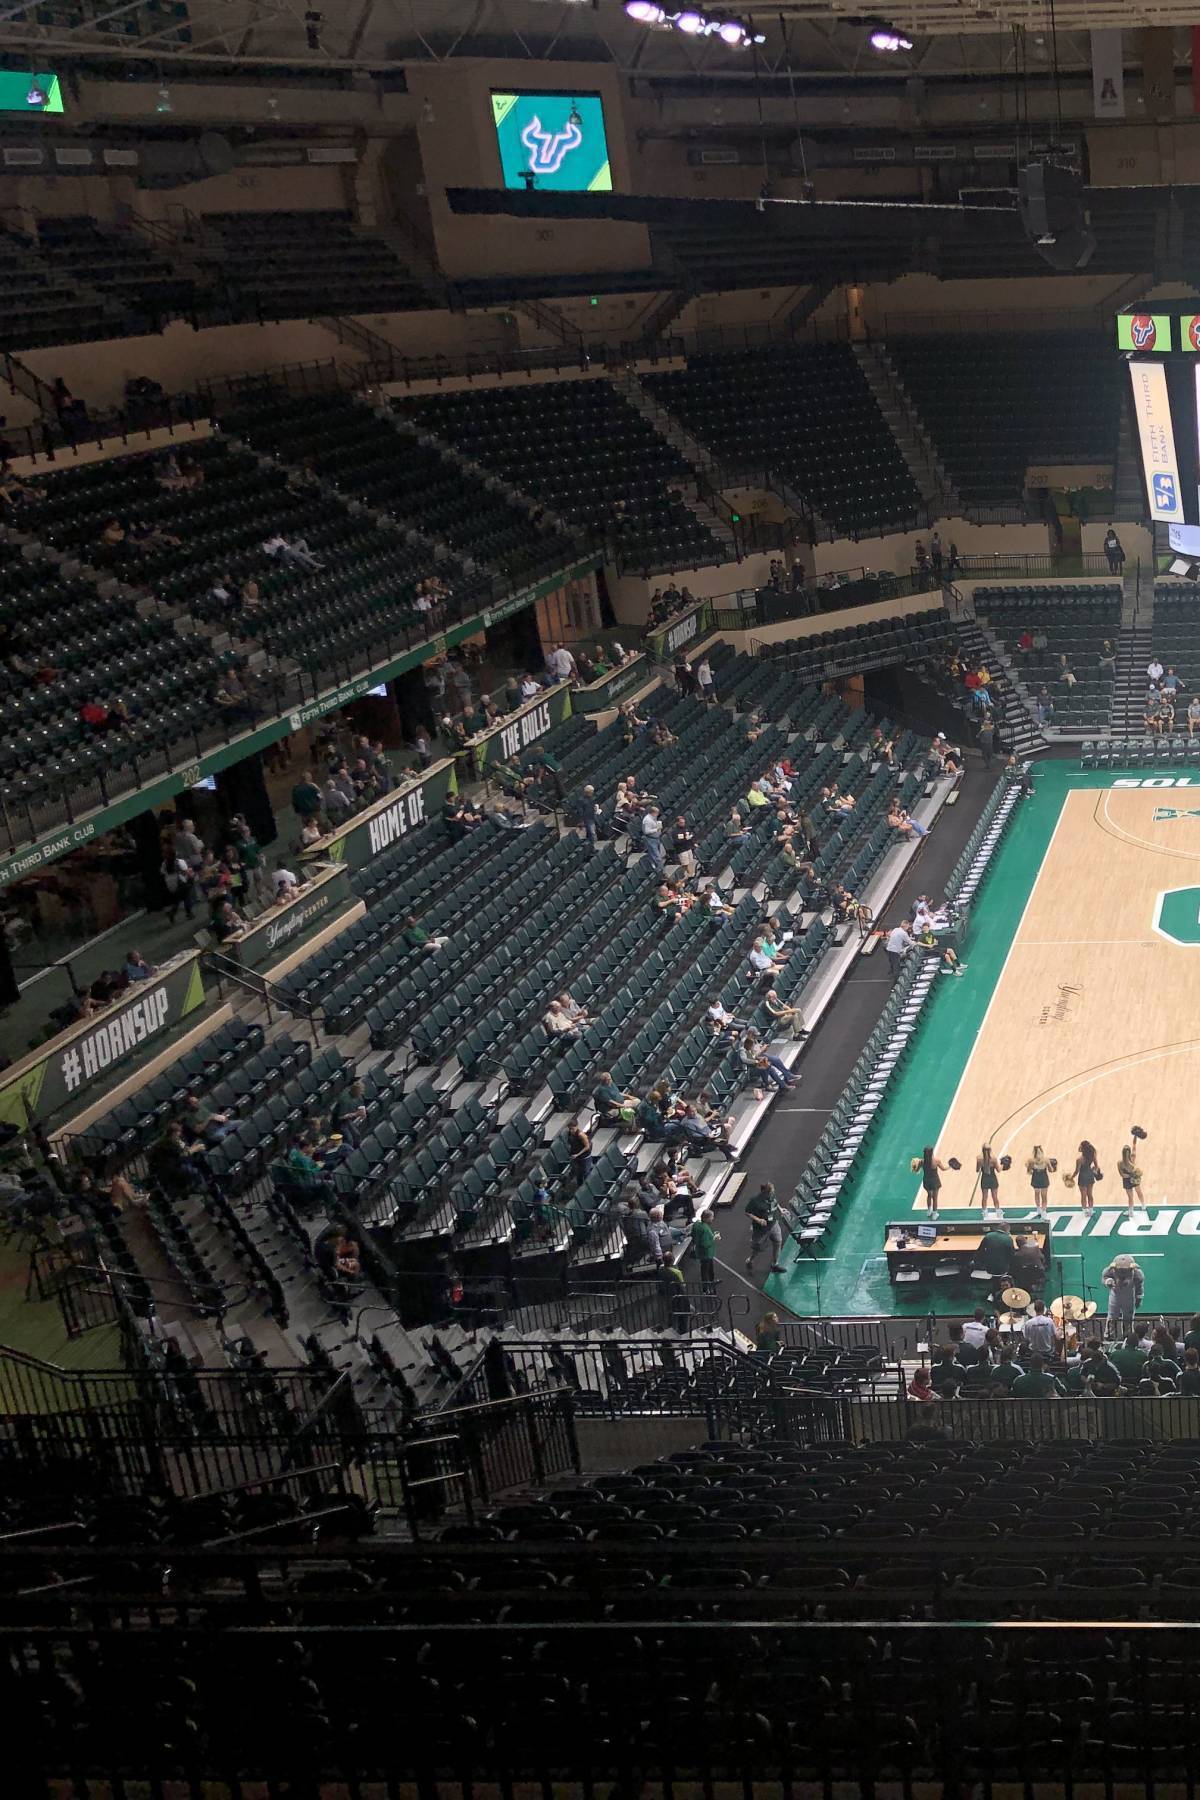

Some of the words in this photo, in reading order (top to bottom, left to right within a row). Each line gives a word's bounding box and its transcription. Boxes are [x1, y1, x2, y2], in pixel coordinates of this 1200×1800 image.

[1142, 373, 1154, 418] THIRD
[1149, 425, 1160, 463] FIFTH
[1159, 425, 1169, 464] BANK
[301, 707, 320, 723] FIFTH
[320, 698, 338, 715] THIRD
[338, 690, 356, 703] BANK
[500, 721, 520, 760] THE
[521, 702, 550, 745] BULLS
[182, 765, 200, 788] 202
[369, 800, 407, 855] HOME
[407, 787, 425, 826] OF
[10, 852, 42, 875] THIRD
[42, 836, 71, 858] BANK
[74, 824, 95, 841] CLUB
[303, 895, 328, 919] CENTER
[61, 986, 169, 1092] #HORNSUP
